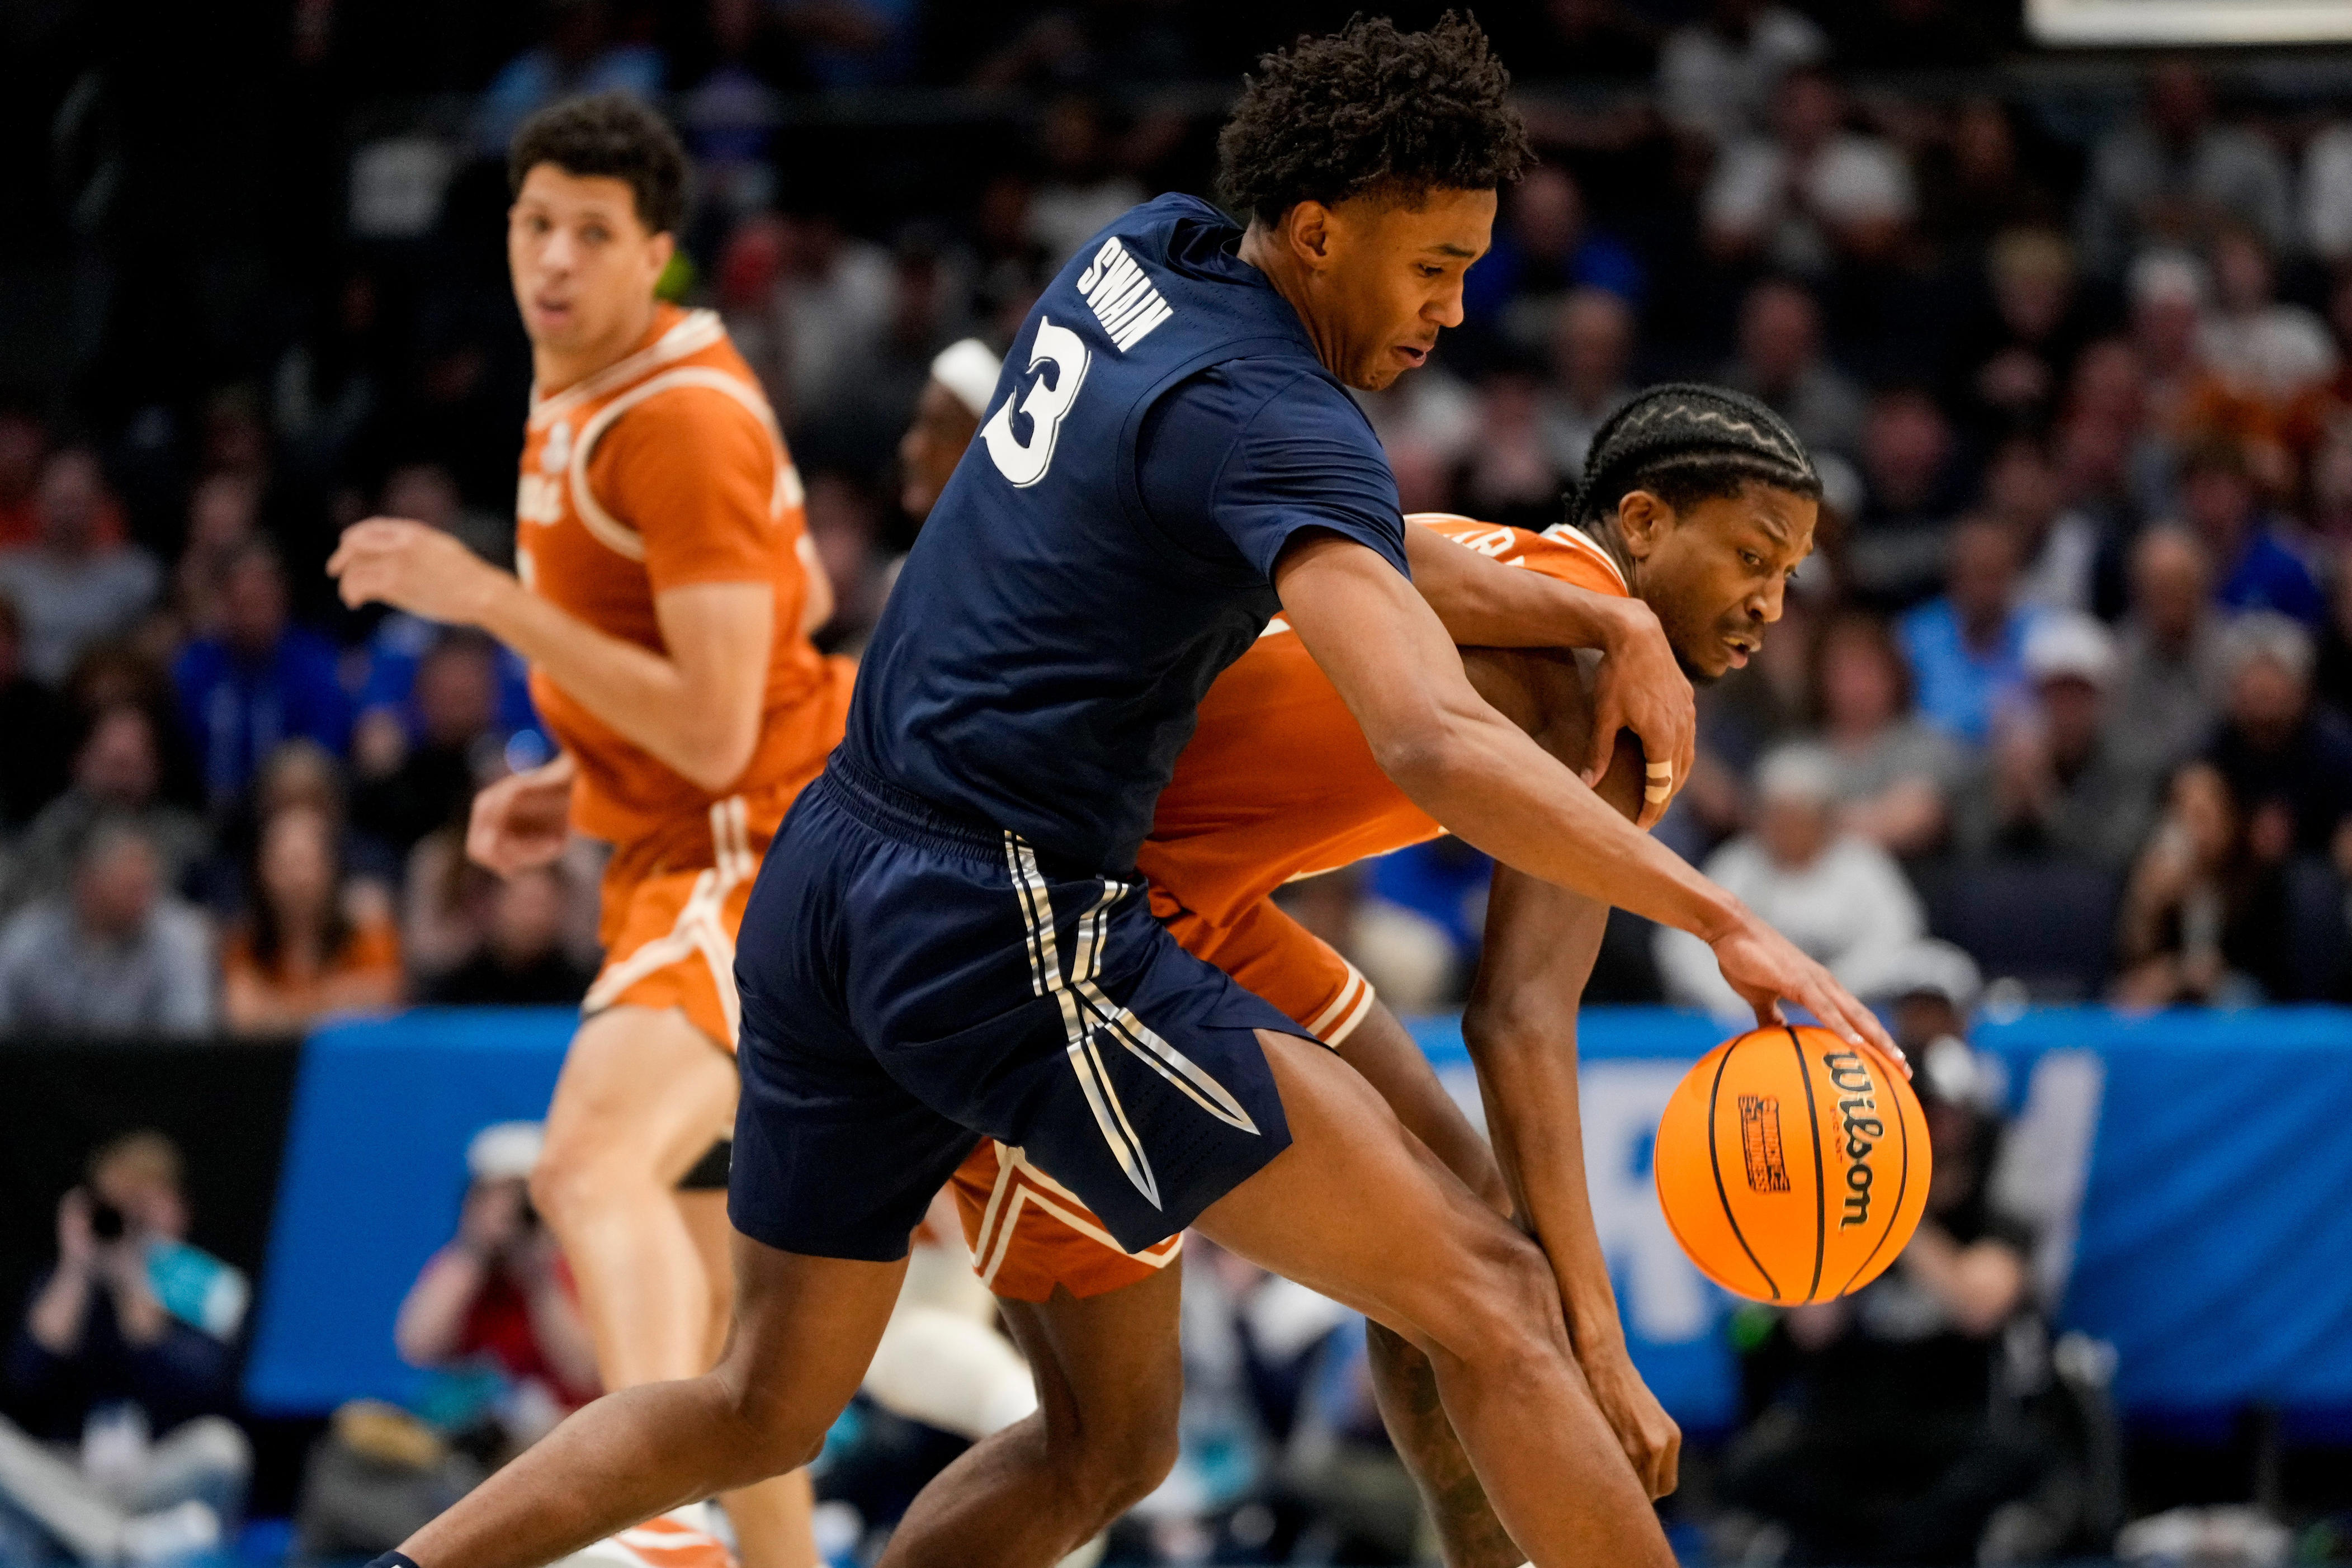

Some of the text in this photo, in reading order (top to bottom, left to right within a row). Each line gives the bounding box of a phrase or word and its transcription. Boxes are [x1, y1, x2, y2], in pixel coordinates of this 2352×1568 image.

[1076, 236, 1173, 352] SWAIN
[980, 315, 1091, 488] 3
[1822, 1050, 1885, 1232] Wilson
